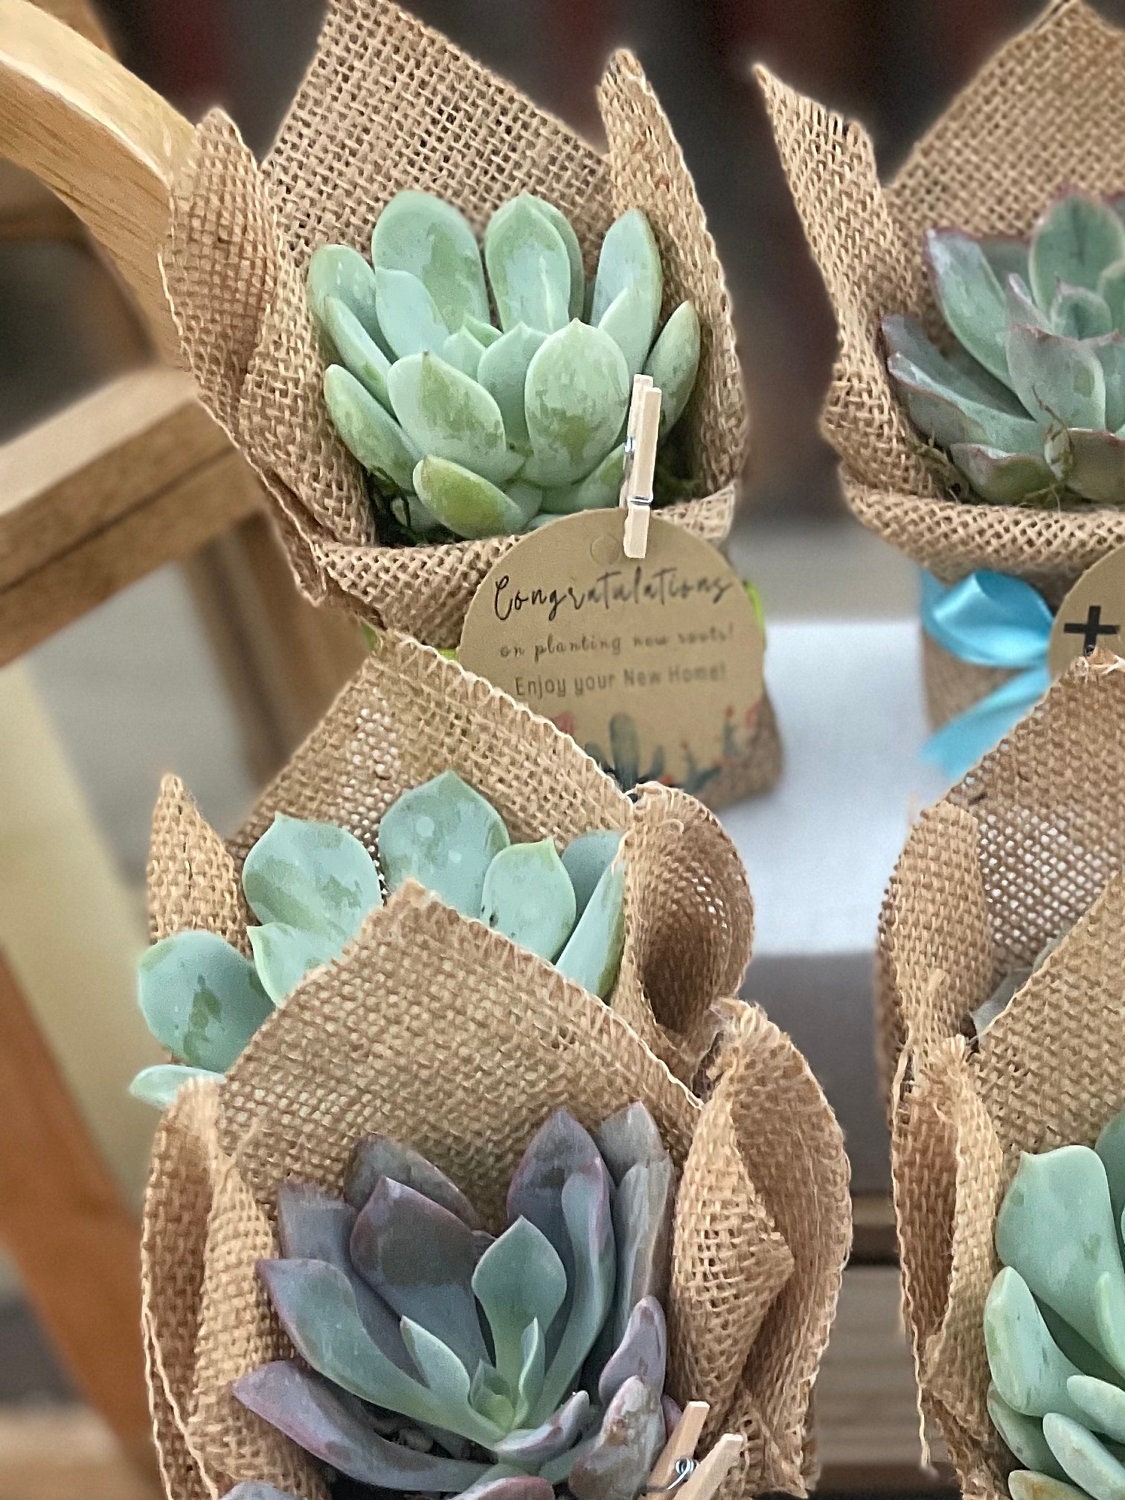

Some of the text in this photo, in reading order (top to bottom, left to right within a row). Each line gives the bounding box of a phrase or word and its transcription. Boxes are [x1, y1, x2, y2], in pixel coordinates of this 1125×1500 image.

[493, 566, 735, 621] Congratulations
[500, 644, 526, 659] on
[534, 635, 621, 662] planting
[632, 635, 669, 649] new
[515, 662, 727, 698] Enjoy your New Home!
